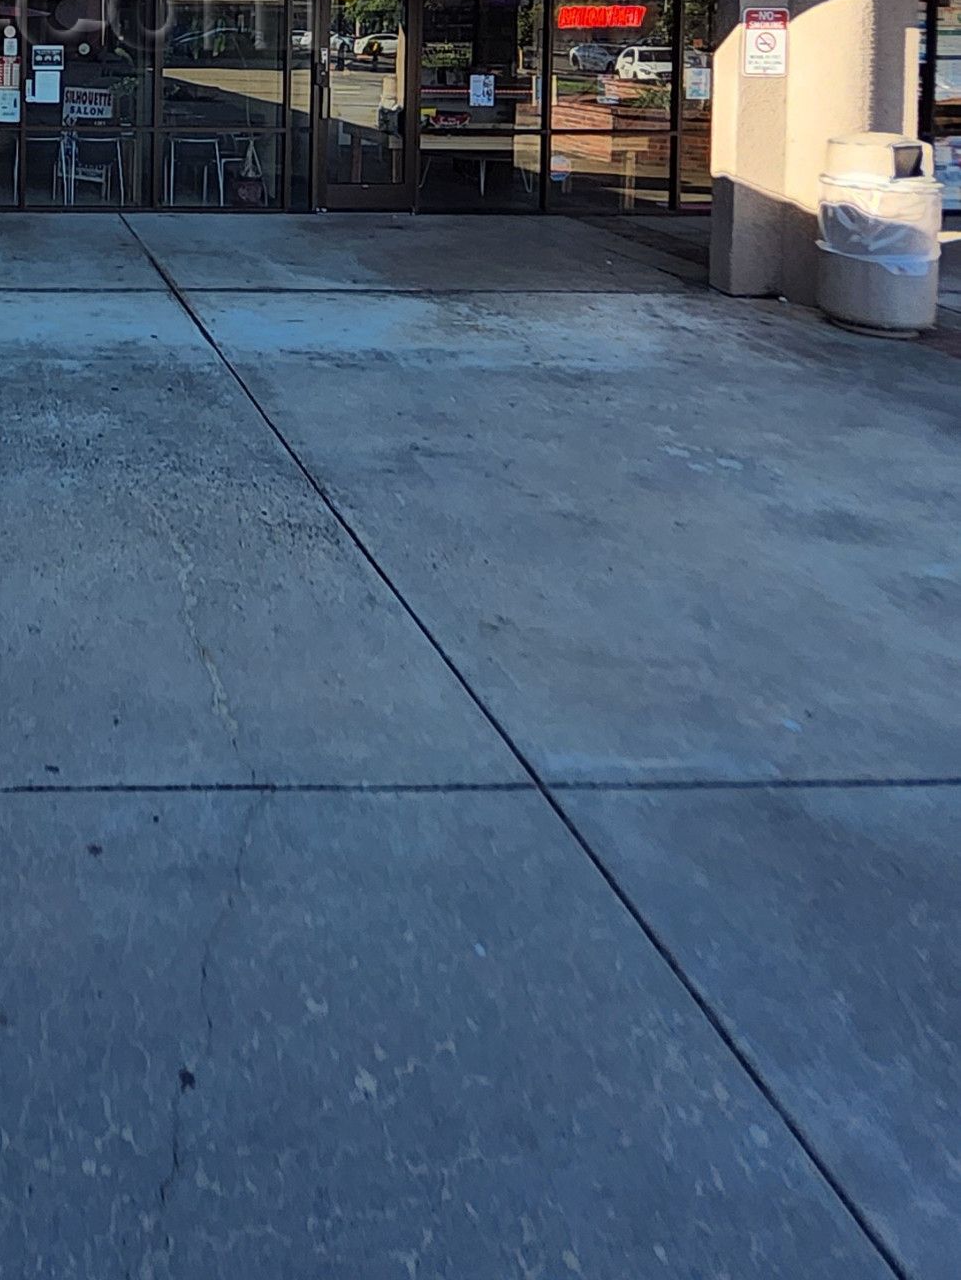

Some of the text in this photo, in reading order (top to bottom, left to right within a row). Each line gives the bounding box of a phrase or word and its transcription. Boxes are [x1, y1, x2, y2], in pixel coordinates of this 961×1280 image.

[758, 11, 774, 21] NO
[65, 90, 112, 107] SILHOUETTE
[70, 105, 104, 116] SALON
